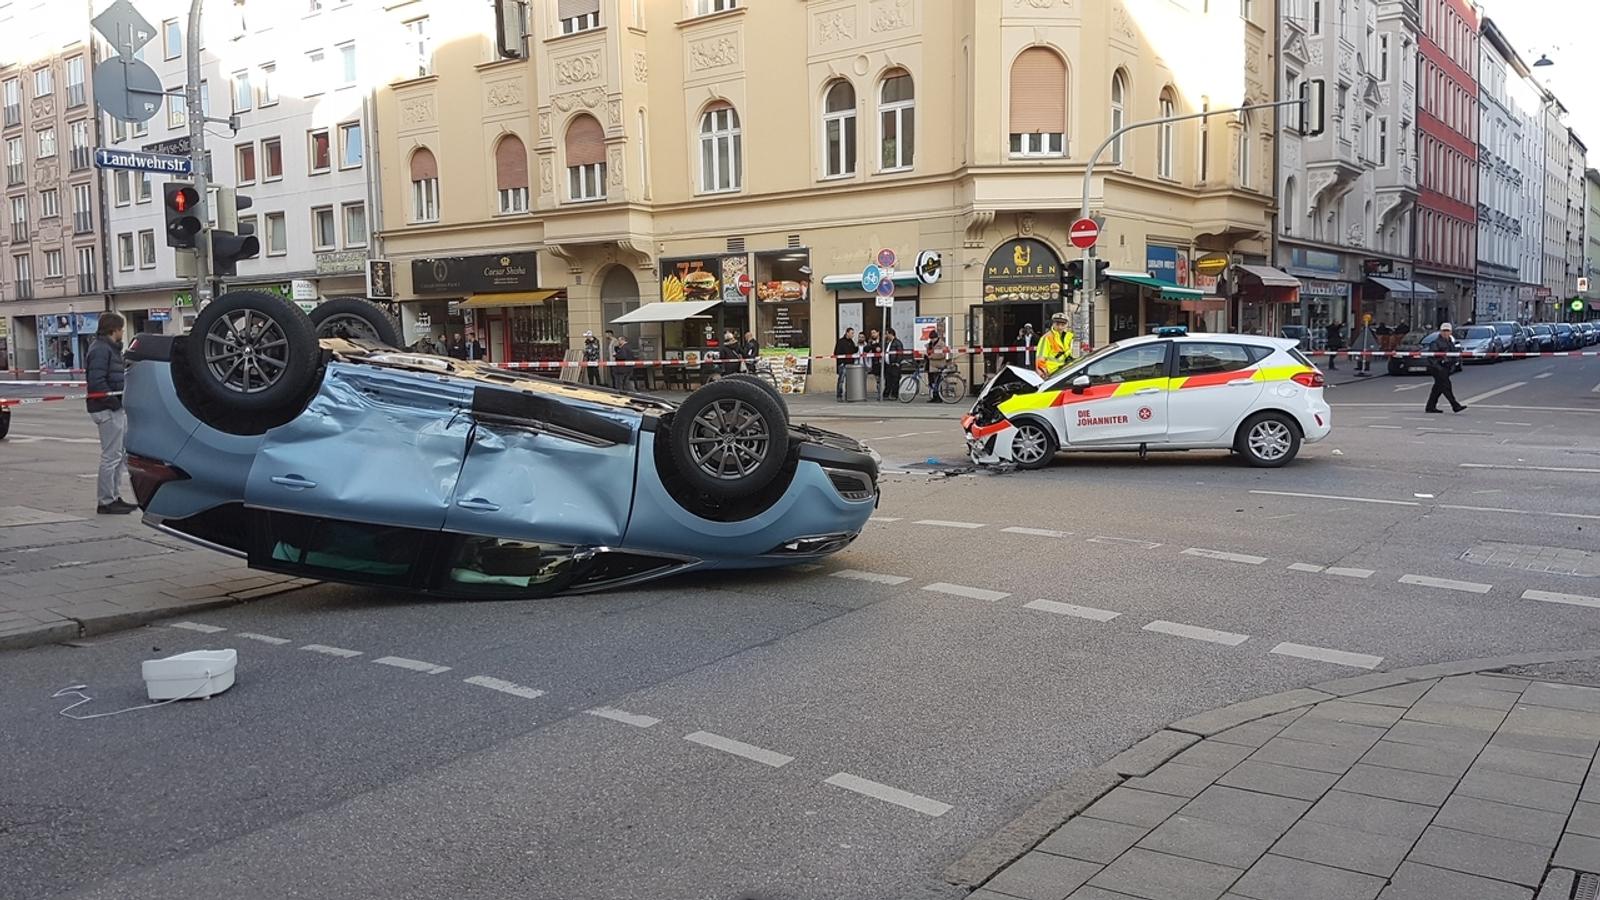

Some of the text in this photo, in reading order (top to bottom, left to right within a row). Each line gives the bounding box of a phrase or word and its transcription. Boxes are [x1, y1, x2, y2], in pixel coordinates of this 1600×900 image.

[102, 151, 187, 171] Landwehrstr.
[505, 265, 526, 276] Shisha
[995, 285, 1050, 293] NEUERÖFFNUNG
[1077, 409, 1091, 418] DIE
[1077, 415, 1129, 427] JOHANNITER
